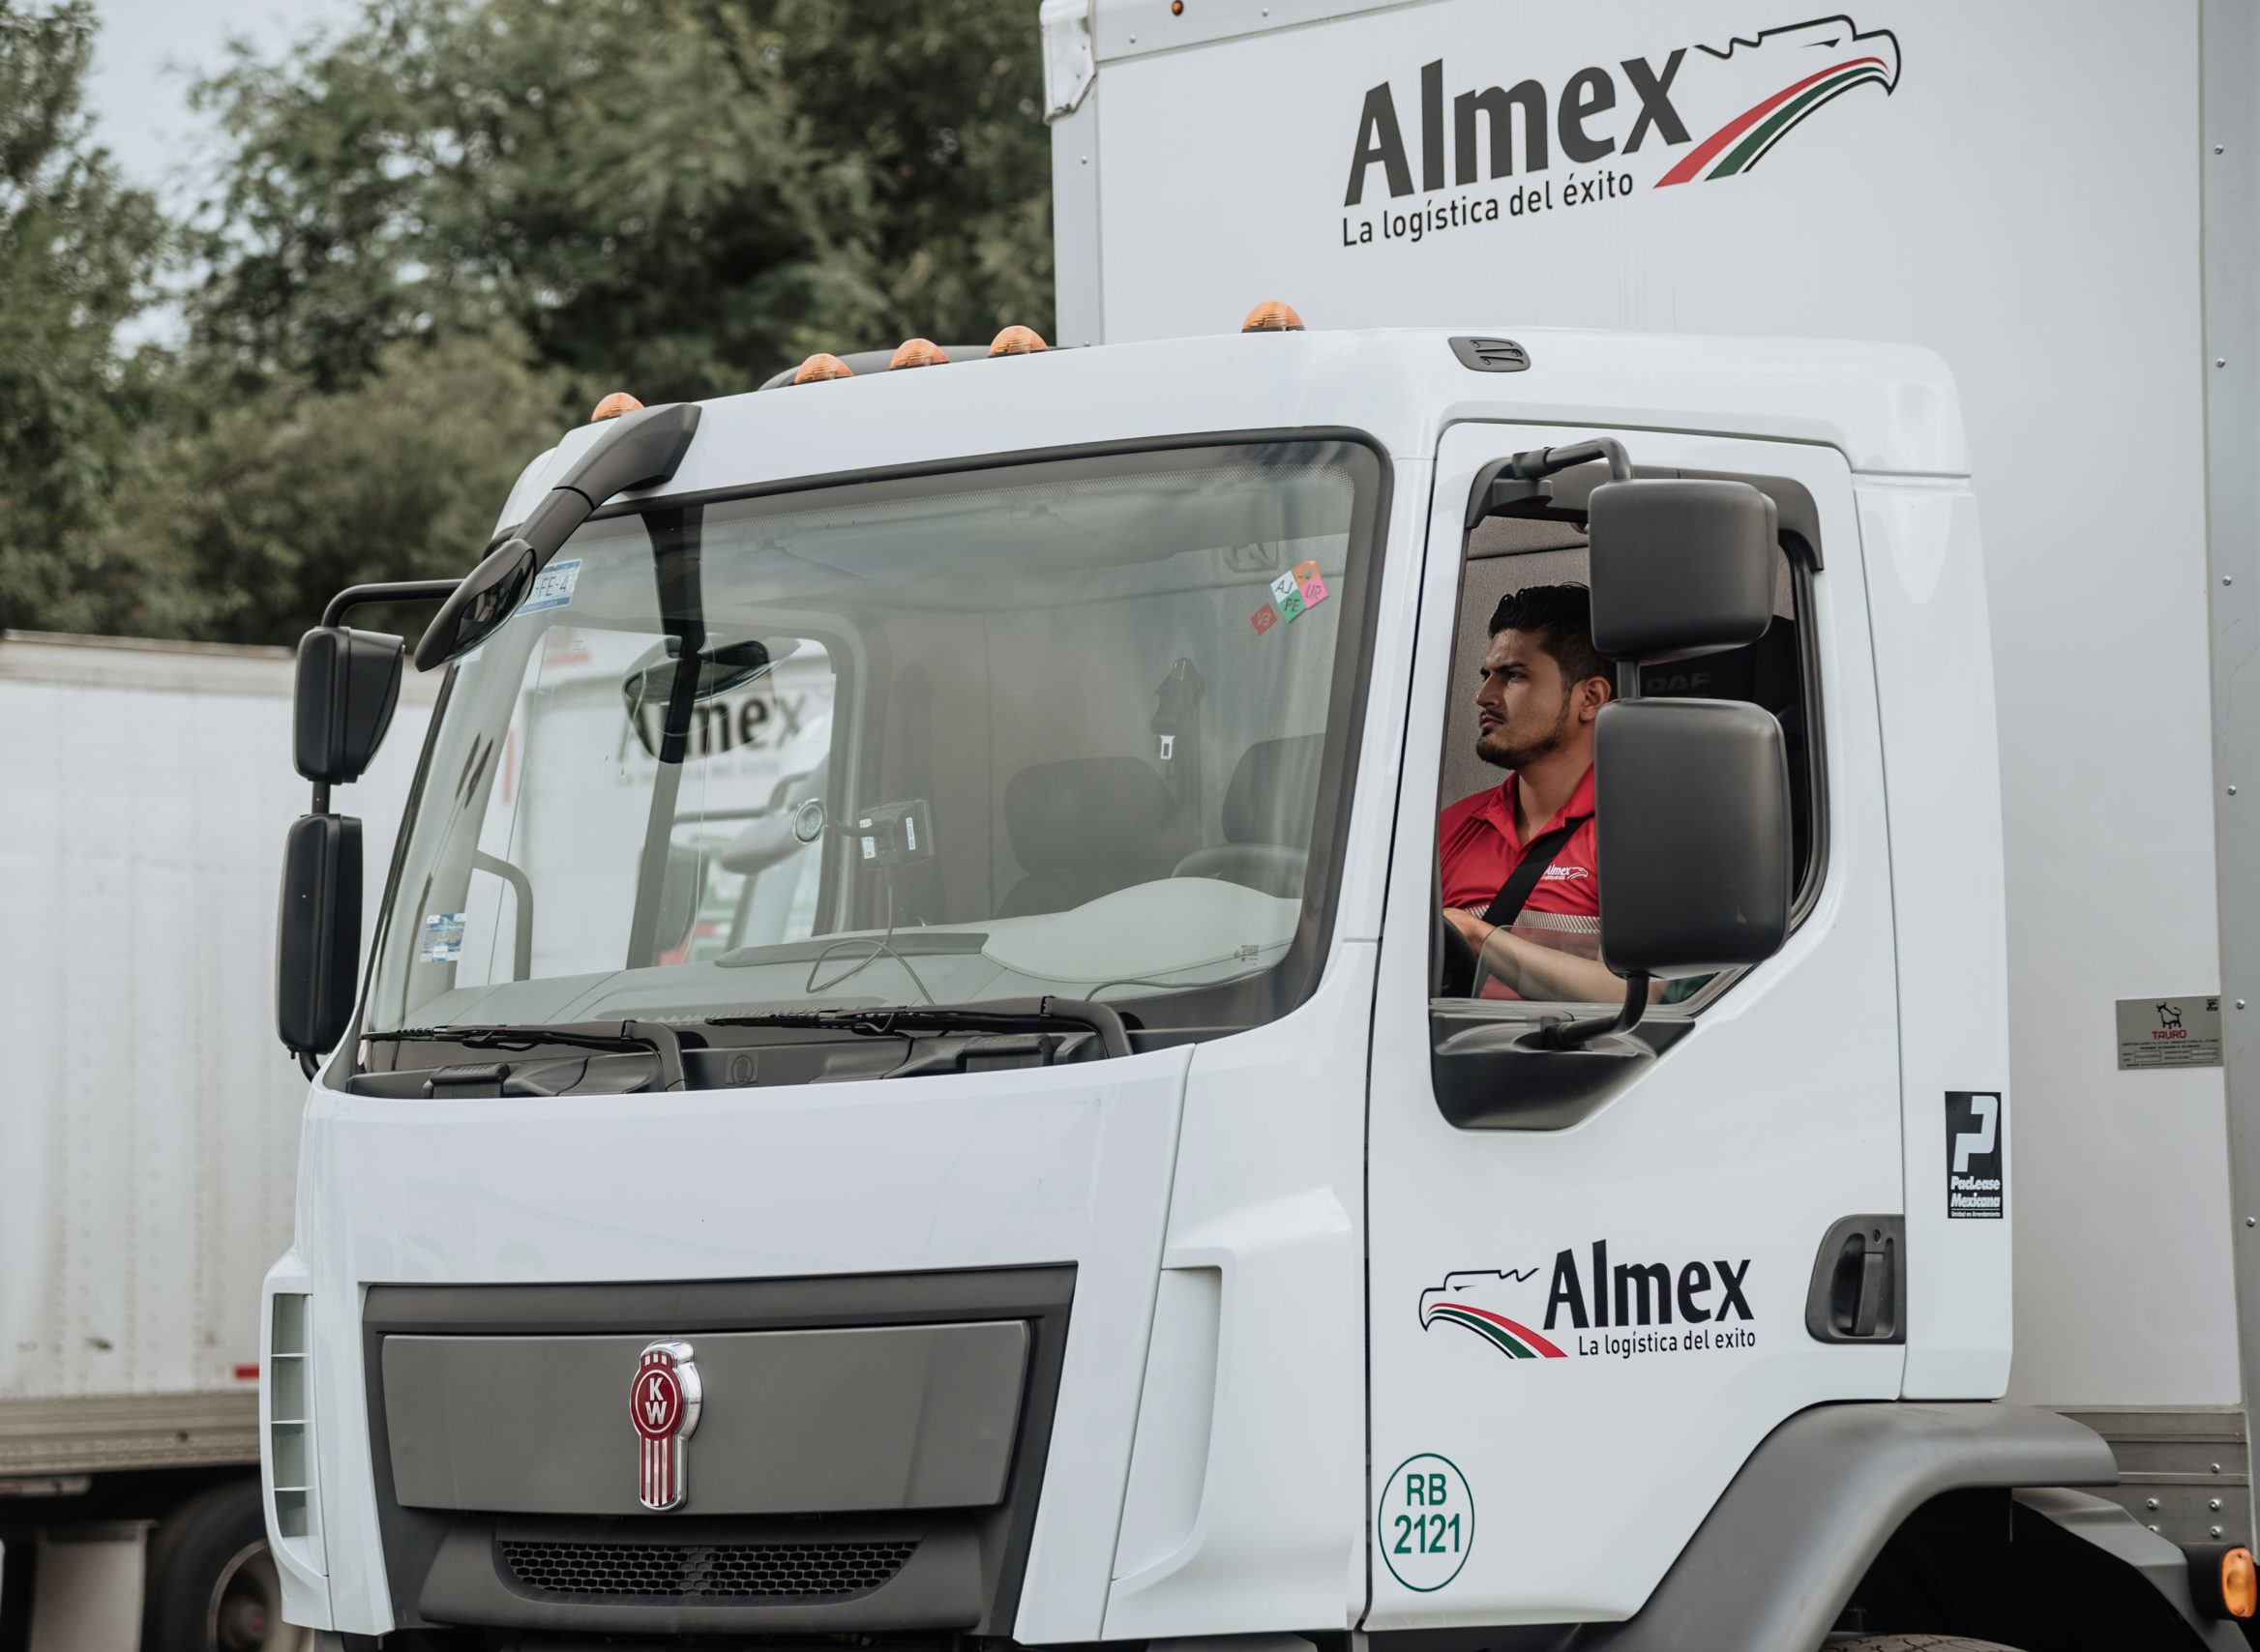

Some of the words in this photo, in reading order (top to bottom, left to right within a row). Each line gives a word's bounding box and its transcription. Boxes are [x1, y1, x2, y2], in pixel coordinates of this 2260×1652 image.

[1344, 48, 1692, 207] Almex
[1343, 218, 1373, 247] La
[1383, 196, 1499, 243] logística
[1510, 181, 1553, 216] del
[1563, 171, 1633, 206] éxito
[1275, 579, 1294, 594] AJ
[1284, 598, 1301, 612] PE
[1646, 671, 1711, 693] DAF
[1543, 864, 1571, 875] Almex
[2152, 1029, 2187, 1040] TAURO
[1950, 1176, 2001, 1191] PacLease
[1950, 1193, 2001, 1208] Mexicana
[1543, 1239, 1754, 1330] Almex
[1578, 1335, 1598, 1356] La
[1606, 1331, 1678, 1359] logística
[1684, 1329, 1710, 1351] del
[1715, 1328, 1756, 1349] exito
[649, 1377, 664, 1401] K
[644, 1401, 668, 1425] W
[1407, 1473, 1447, 1507] RB
[1393, 1513, 1460, 1554] 2121
